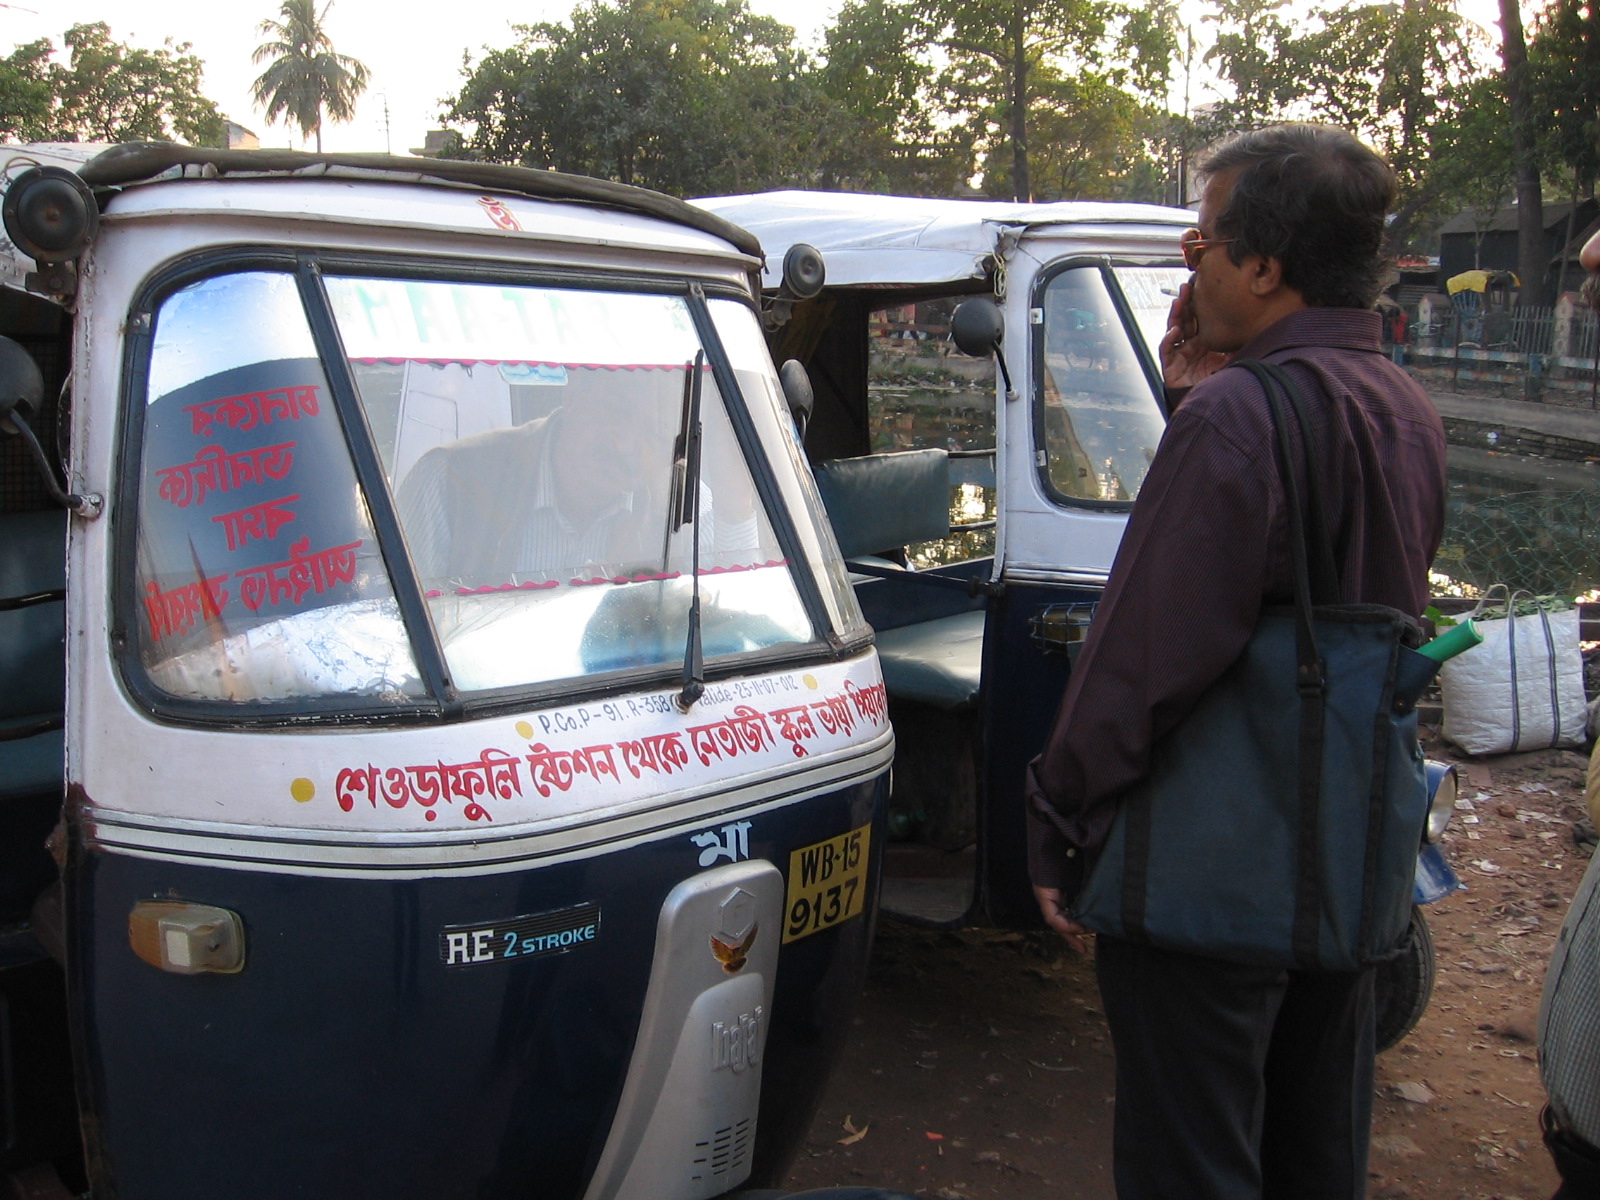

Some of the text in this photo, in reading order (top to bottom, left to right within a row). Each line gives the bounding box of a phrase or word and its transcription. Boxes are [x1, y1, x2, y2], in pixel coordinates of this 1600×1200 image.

[617, 731, 688, 779] থেকে
[686, 705, 777, 767] নেতাজী
[769, 703, 820, 758] স্কুল
[690, 820, 753, 867] মা
[800, 832, 862, 888] WB-15
[787, 877, 859, 936] 9137
[446, 924, 596, 966] RE 2 STROKE
